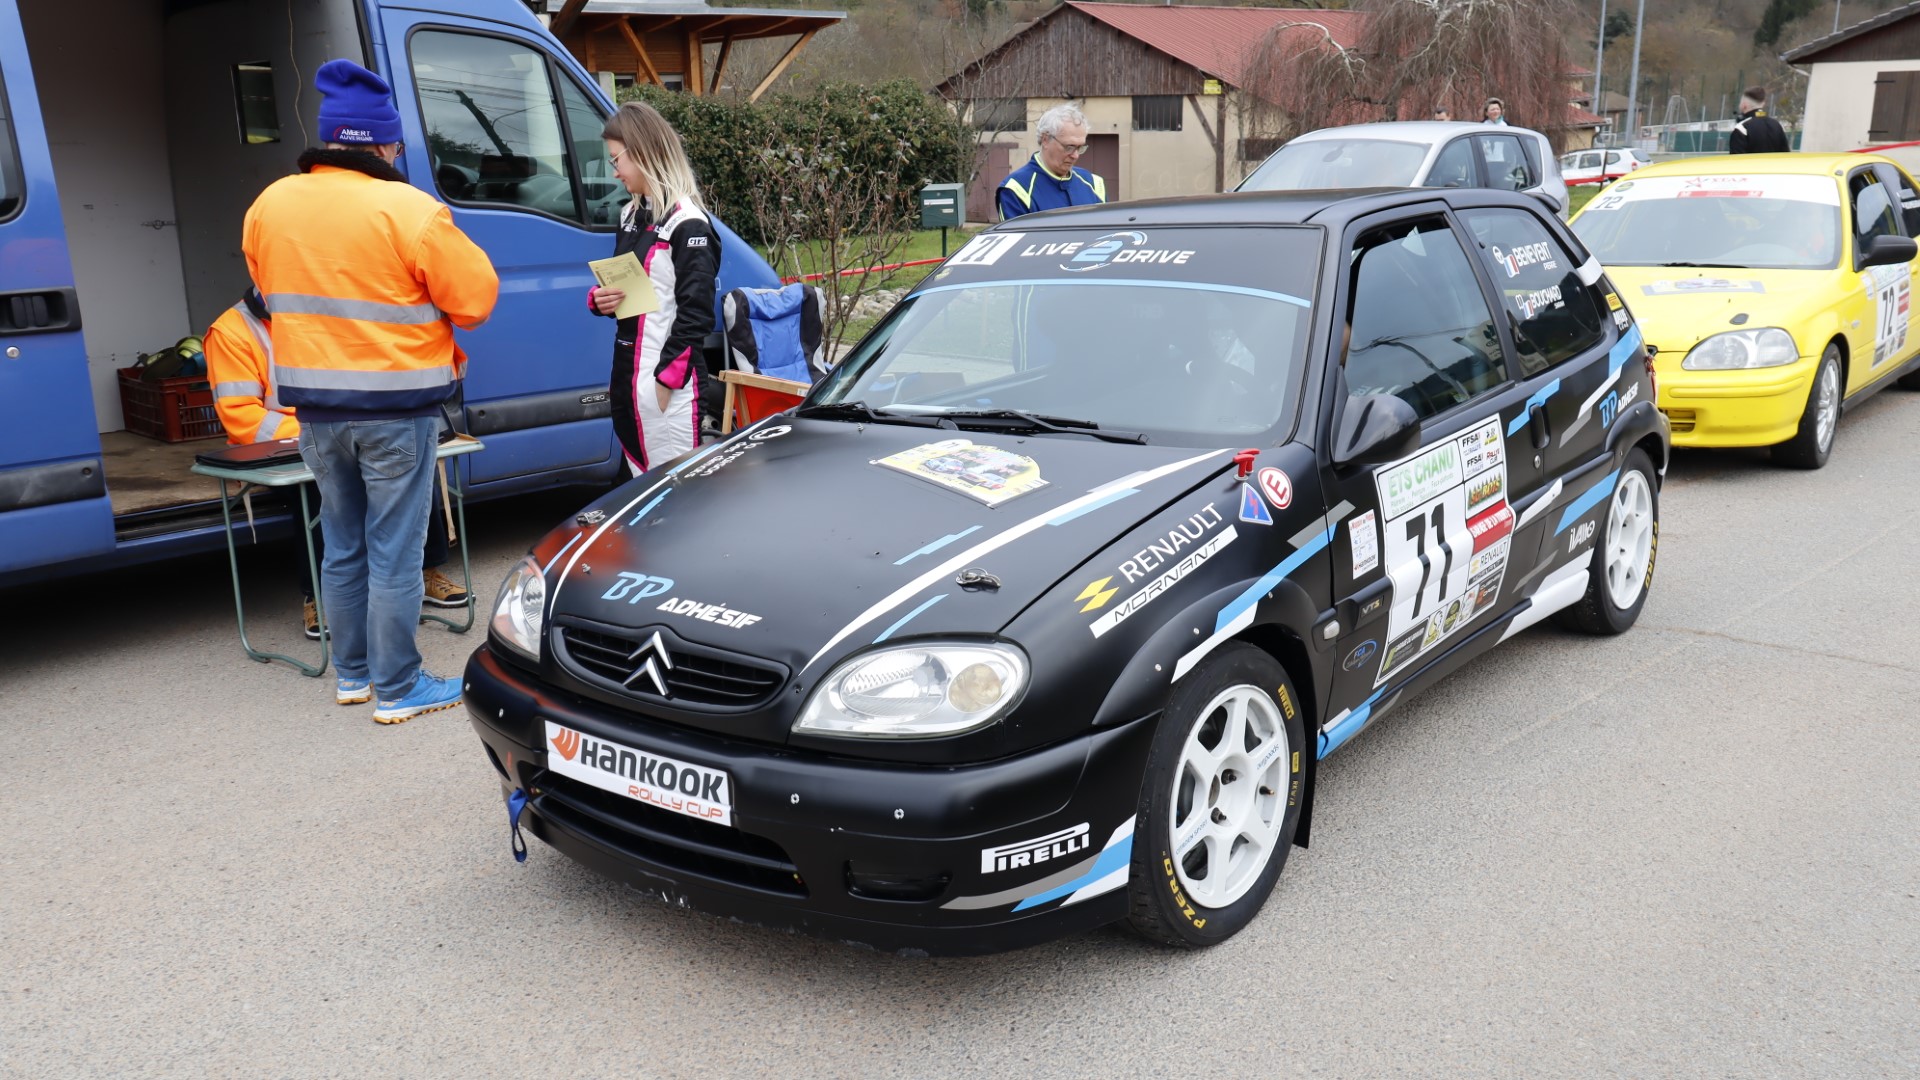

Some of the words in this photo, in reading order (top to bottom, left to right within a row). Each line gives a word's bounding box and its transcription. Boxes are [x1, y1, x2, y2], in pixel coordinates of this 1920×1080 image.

[341, 128, 371, 137] AMBERT
[961, 235, 1001, 262] 71
[1020, 241, 1085, 257] LIVE
[1071, 240, 1123, 262] 2
[1112, 249, 1197, 265] DRIVE
[1512, 241, 1553, 268] BENEVENT
[1529, 284, 1563, 309] BOUCHARD
[1388, 466, 1413, 499] ETS
[1414, 445, 1456, 486] CHANU
[1266, 474, 1287, 500] E
[1118, 502, 1223, 584] RENAULT
[1480, 541, 1507, 566] RENAULT
[1406, 502, 1453, 621] 71
[1114, 538, 1219, 622] MORNANT
[600, 571, 675, 605] BP
[656, 597, 763, 629] ADHÉSIF
[1362, 599, 1381, 614] VTS
[686, 801, 723, 819] CUP
[981, 821, 1090, 874] PIRELLI
